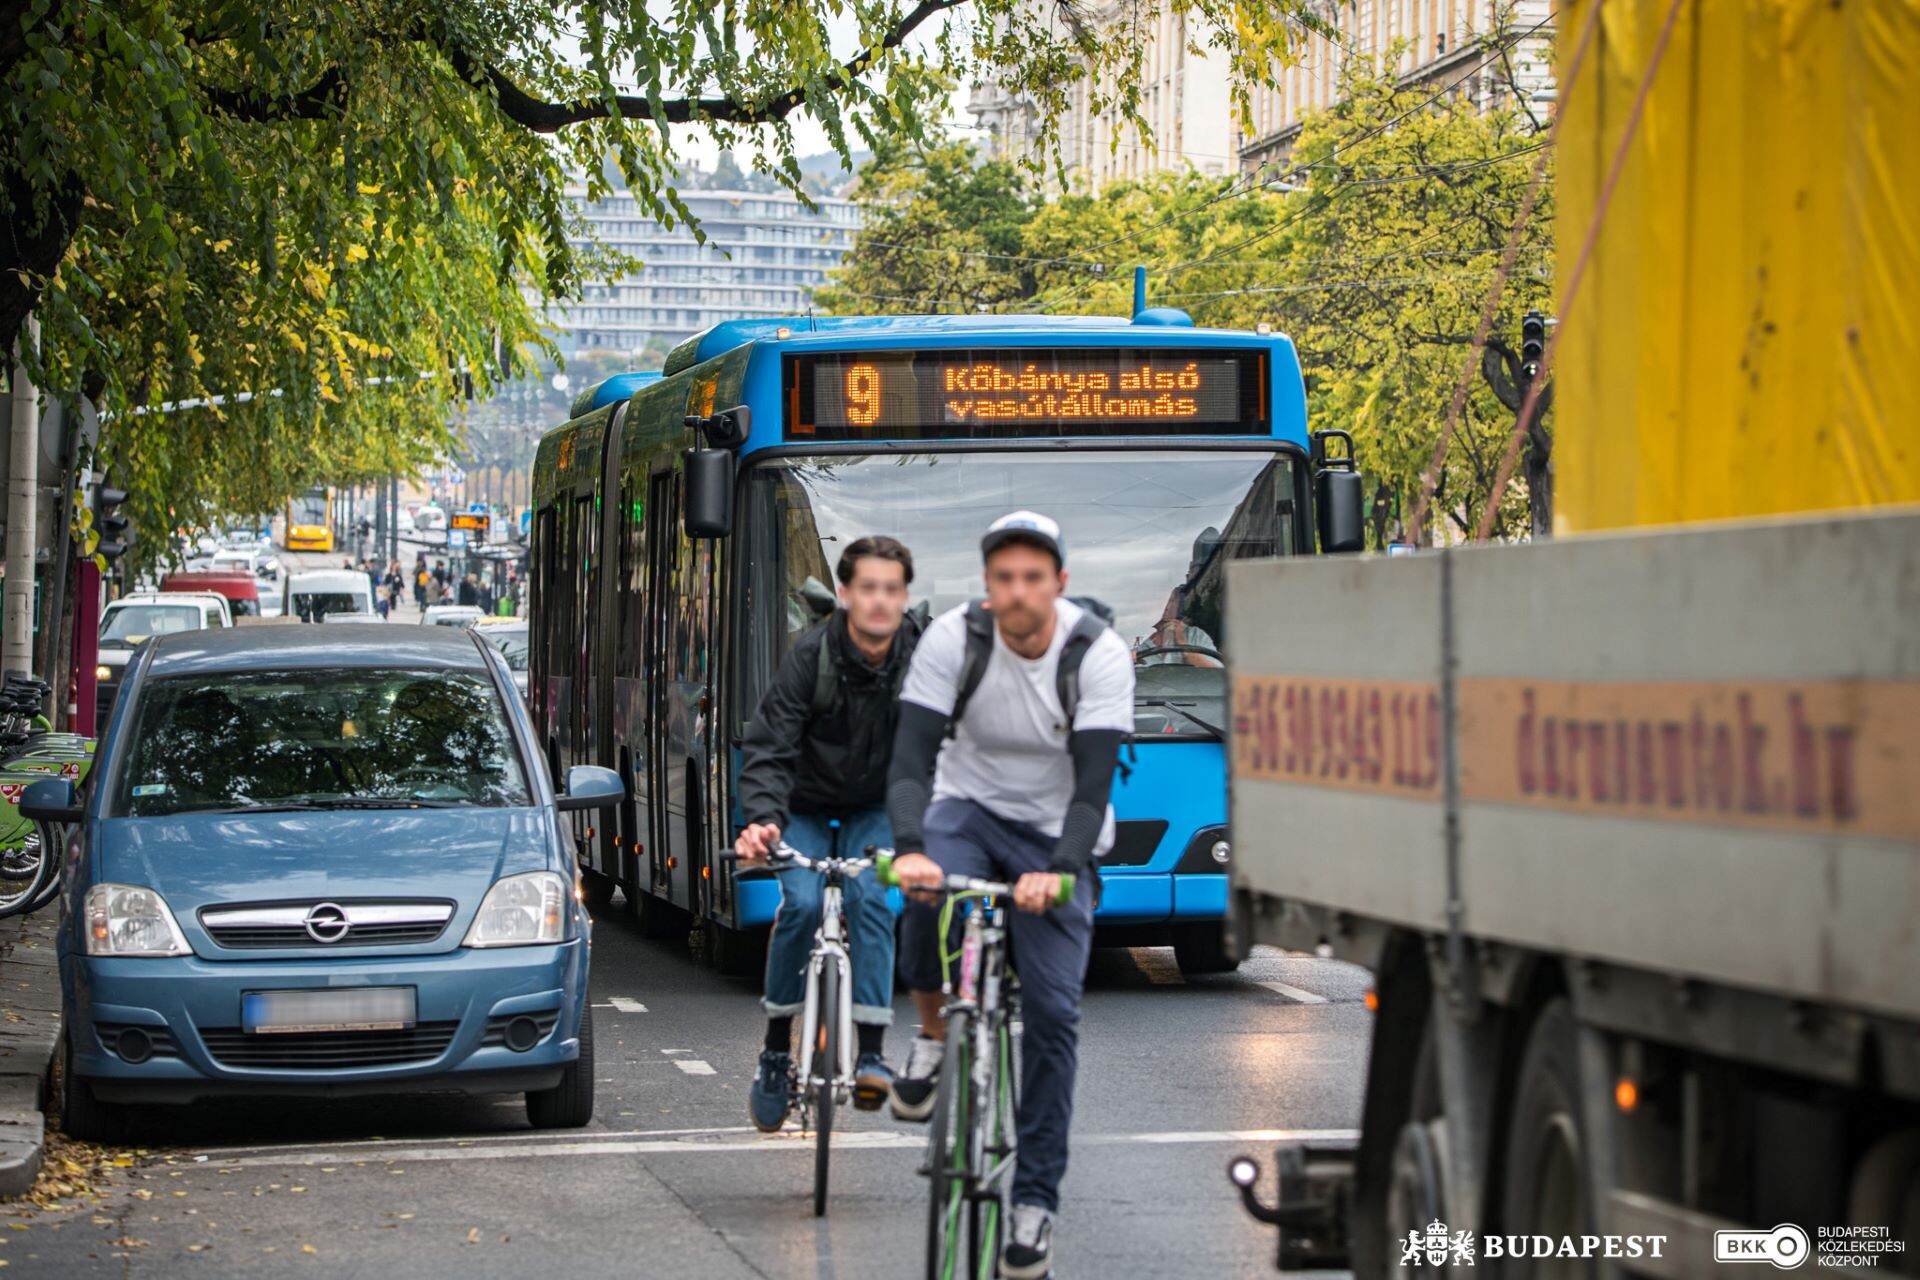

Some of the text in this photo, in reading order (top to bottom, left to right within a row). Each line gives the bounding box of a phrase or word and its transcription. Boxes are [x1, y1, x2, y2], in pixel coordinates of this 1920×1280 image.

[946, 363, 1199, 393] Kőbánya alsó
[847, 366, 880, 424] 9
[949, 394, 1197, 417] vasútállomás
